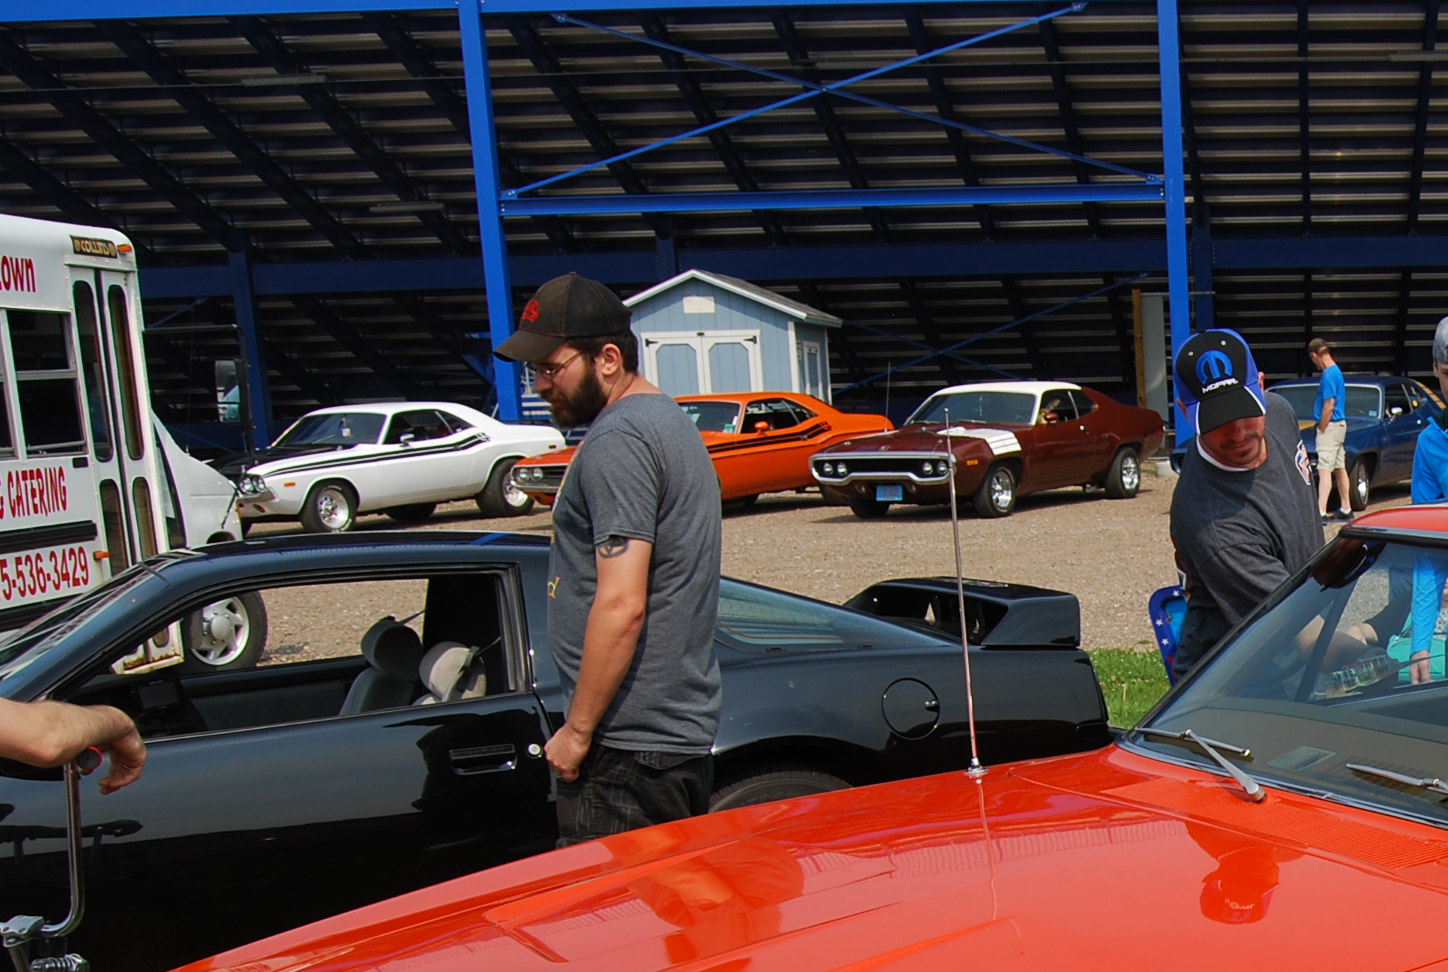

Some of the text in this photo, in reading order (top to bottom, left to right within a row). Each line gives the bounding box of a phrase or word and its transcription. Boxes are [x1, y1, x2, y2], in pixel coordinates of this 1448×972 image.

[0, 255, 36, 293] own
[1202, 378, 1236, 394] MOPAR
[8, 466, 67, 518] CATERING
